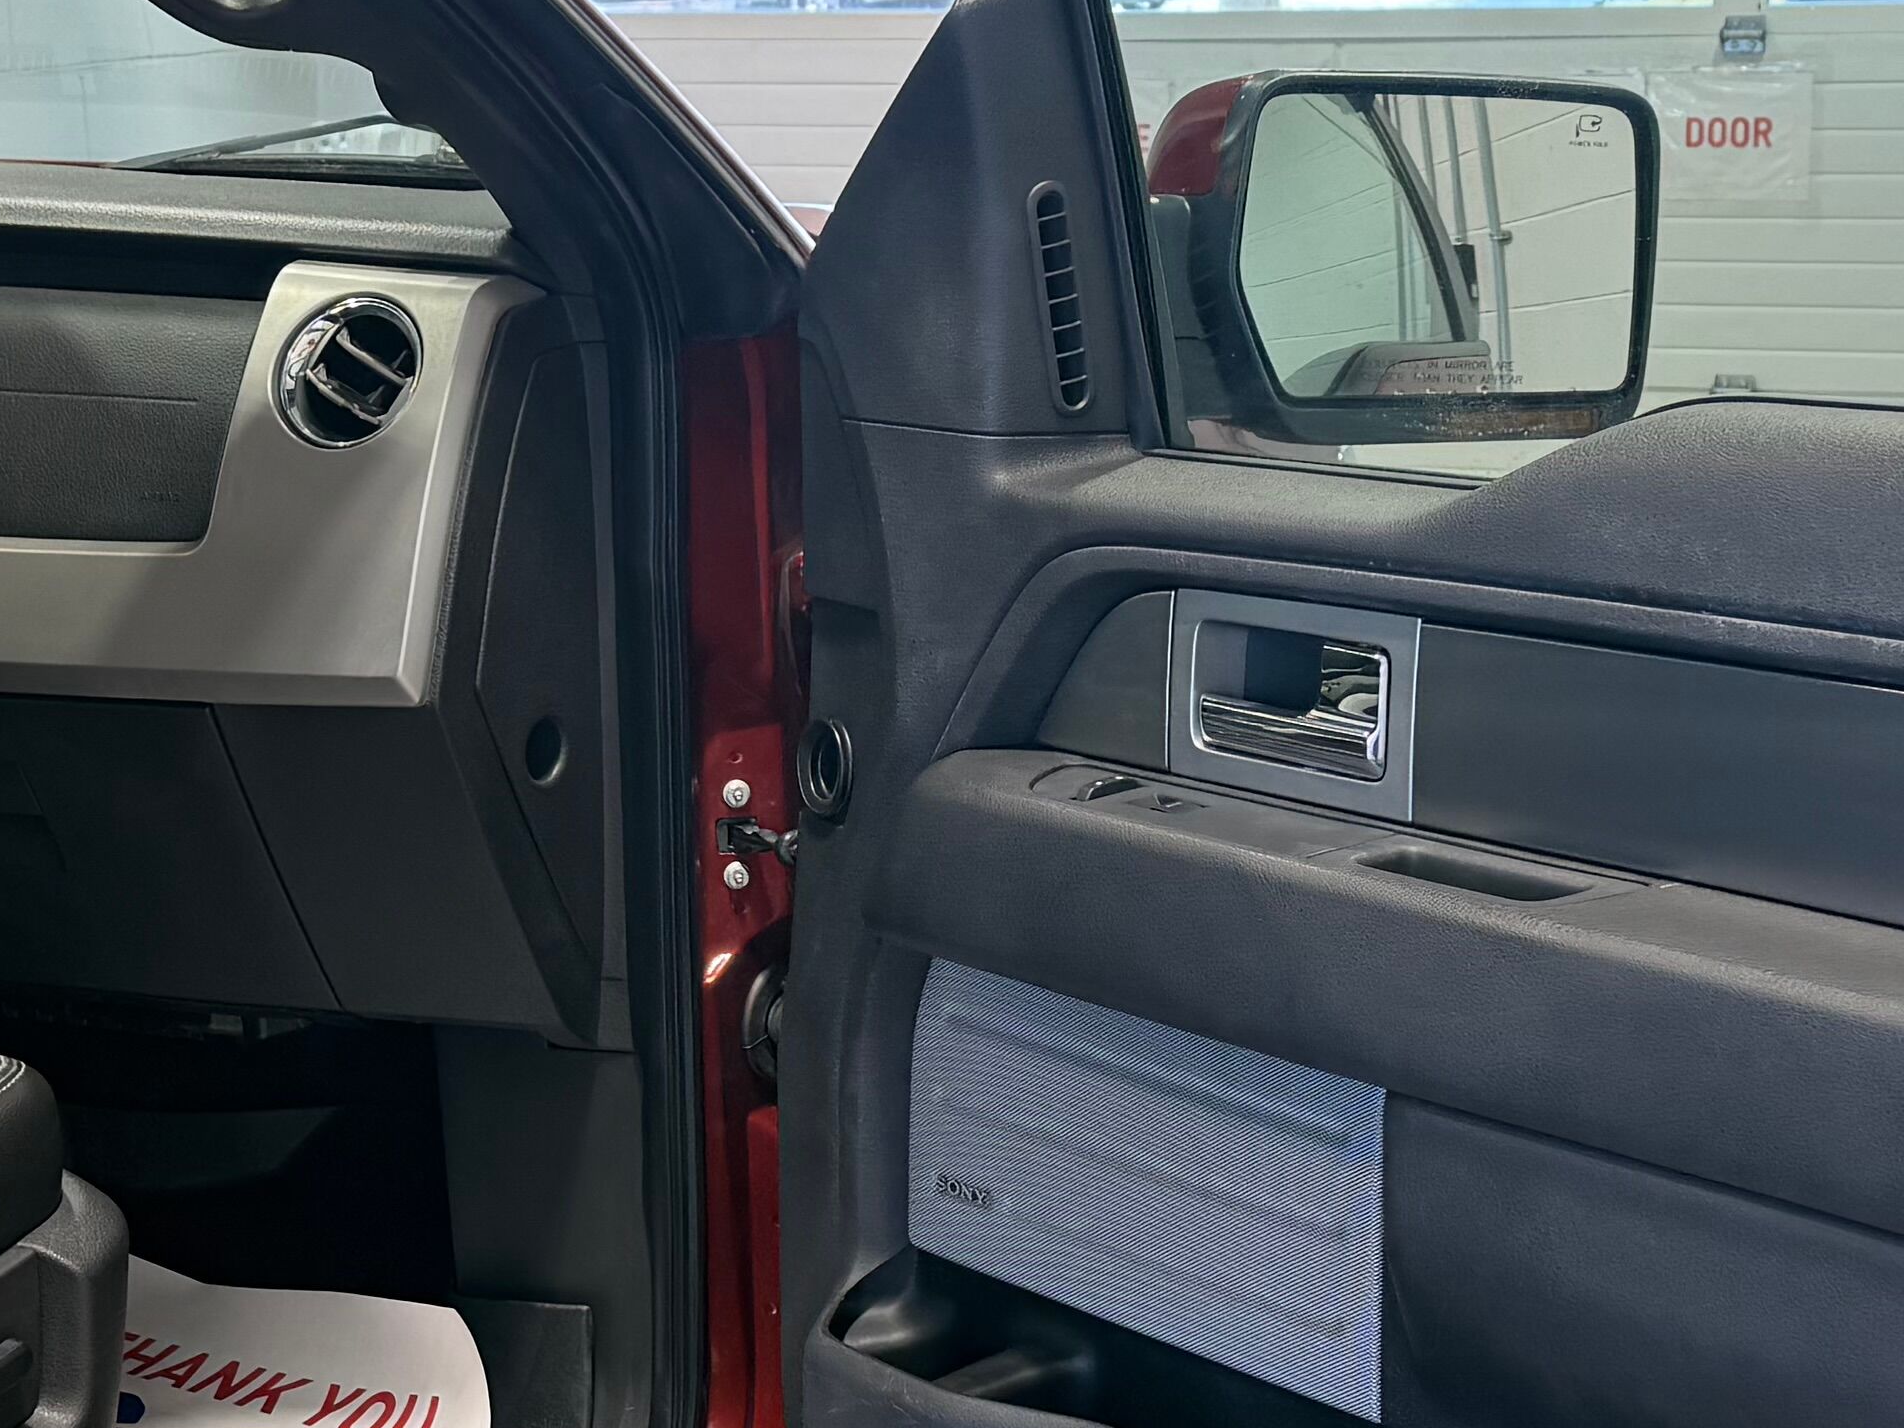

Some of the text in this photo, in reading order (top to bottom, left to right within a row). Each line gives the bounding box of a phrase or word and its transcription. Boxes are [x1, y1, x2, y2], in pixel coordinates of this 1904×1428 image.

[1685, 116, 1773, 149] DOOR
[936, 1175, 988, 1205] SONY
[123, 1332, 314, 1415] HANK
